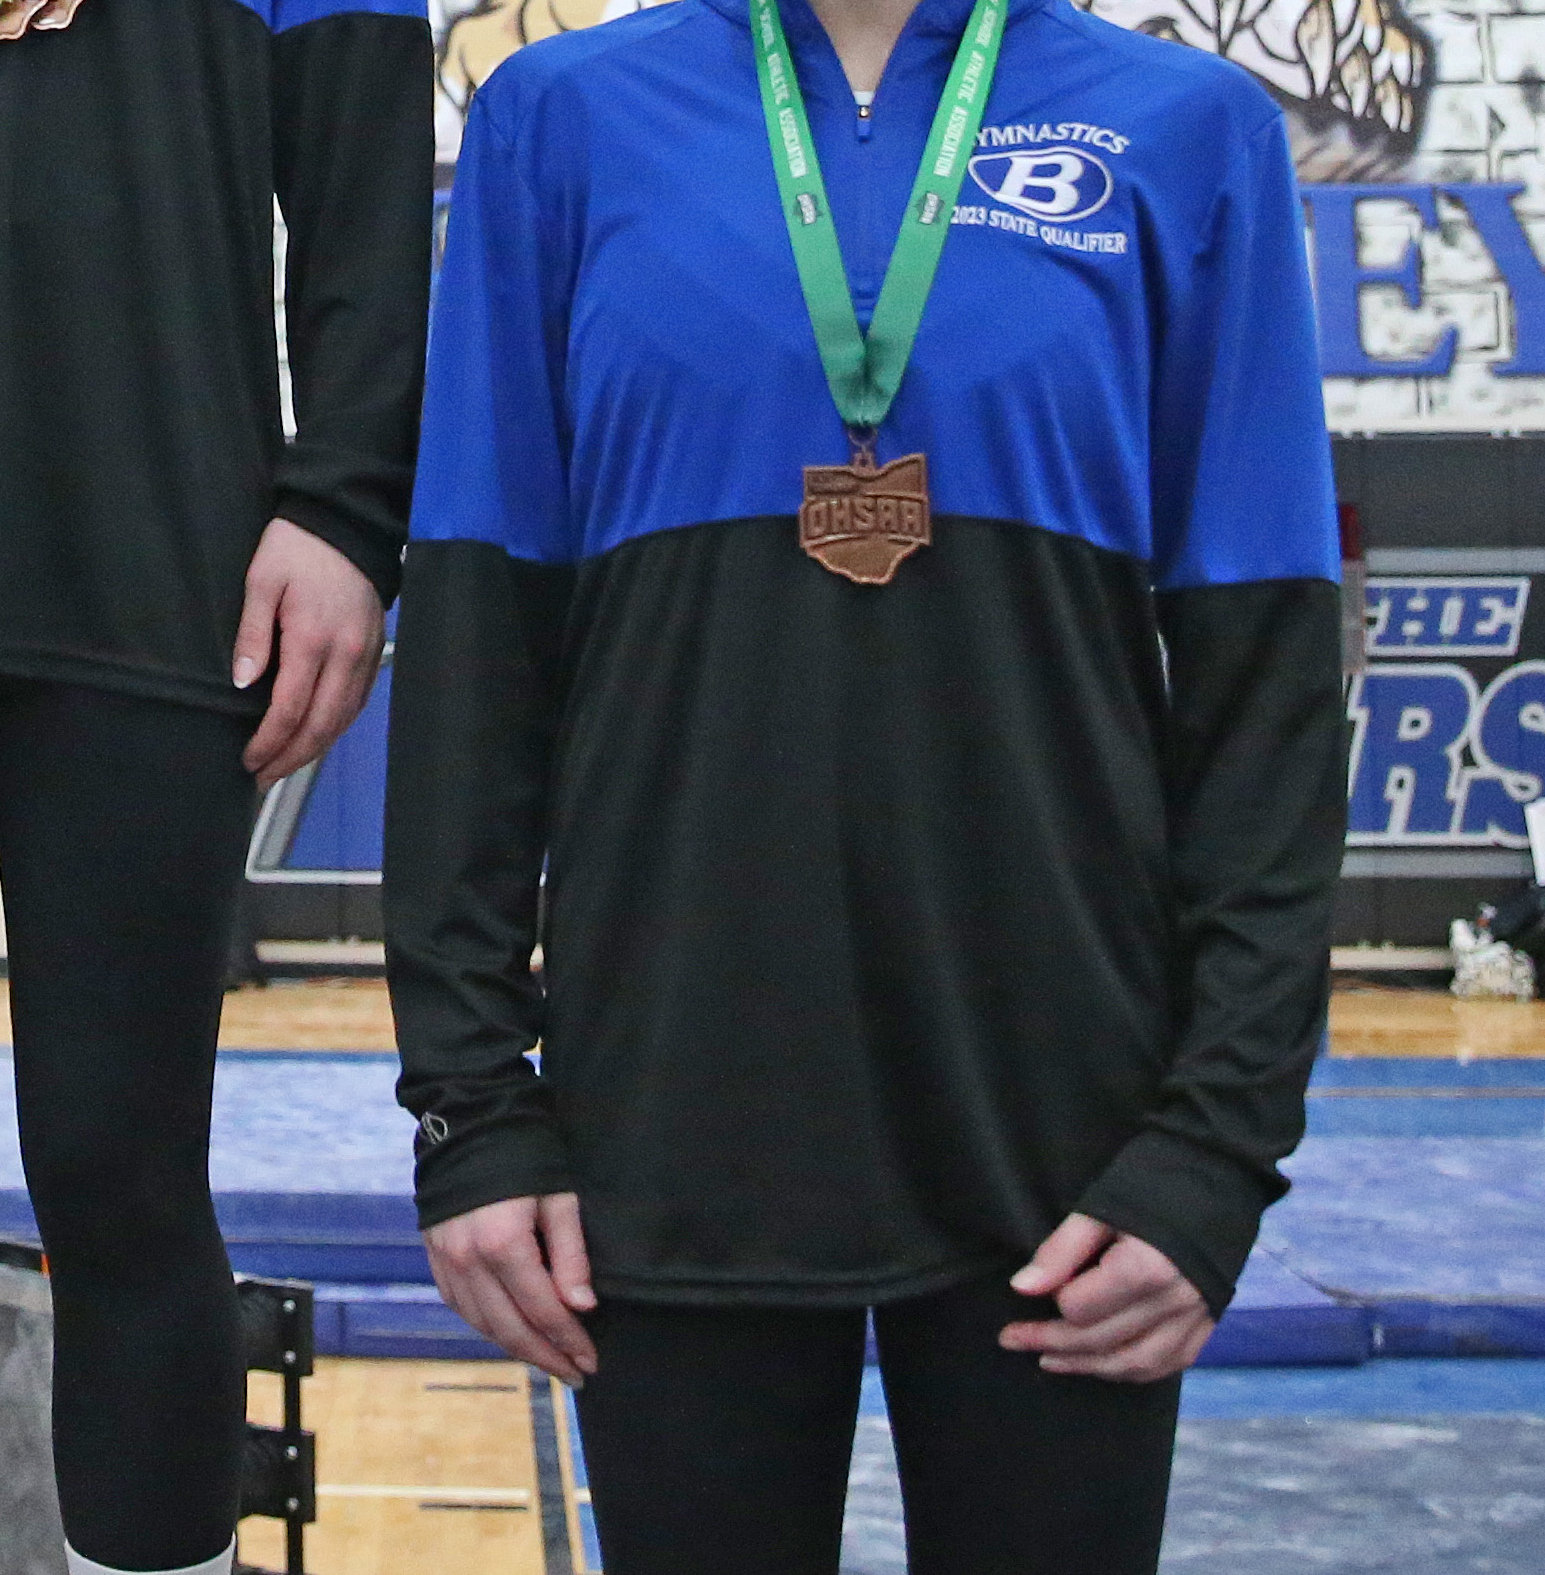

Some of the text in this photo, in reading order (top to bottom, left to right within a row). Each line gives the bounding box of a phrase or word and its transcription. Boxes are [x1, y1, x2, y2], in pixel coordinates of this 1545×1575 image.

[933, 105, 969, 178] ASSOCIATION
[976, 122, 1130, 154] YMNASTICS
[995, 153, 1084, 215] B
[950, 205, 1129, 254] 2023 STATE QUALIFIER
[806, 496, 923, 537] OHSAA
[1365, 578, 1530, 657] HE
